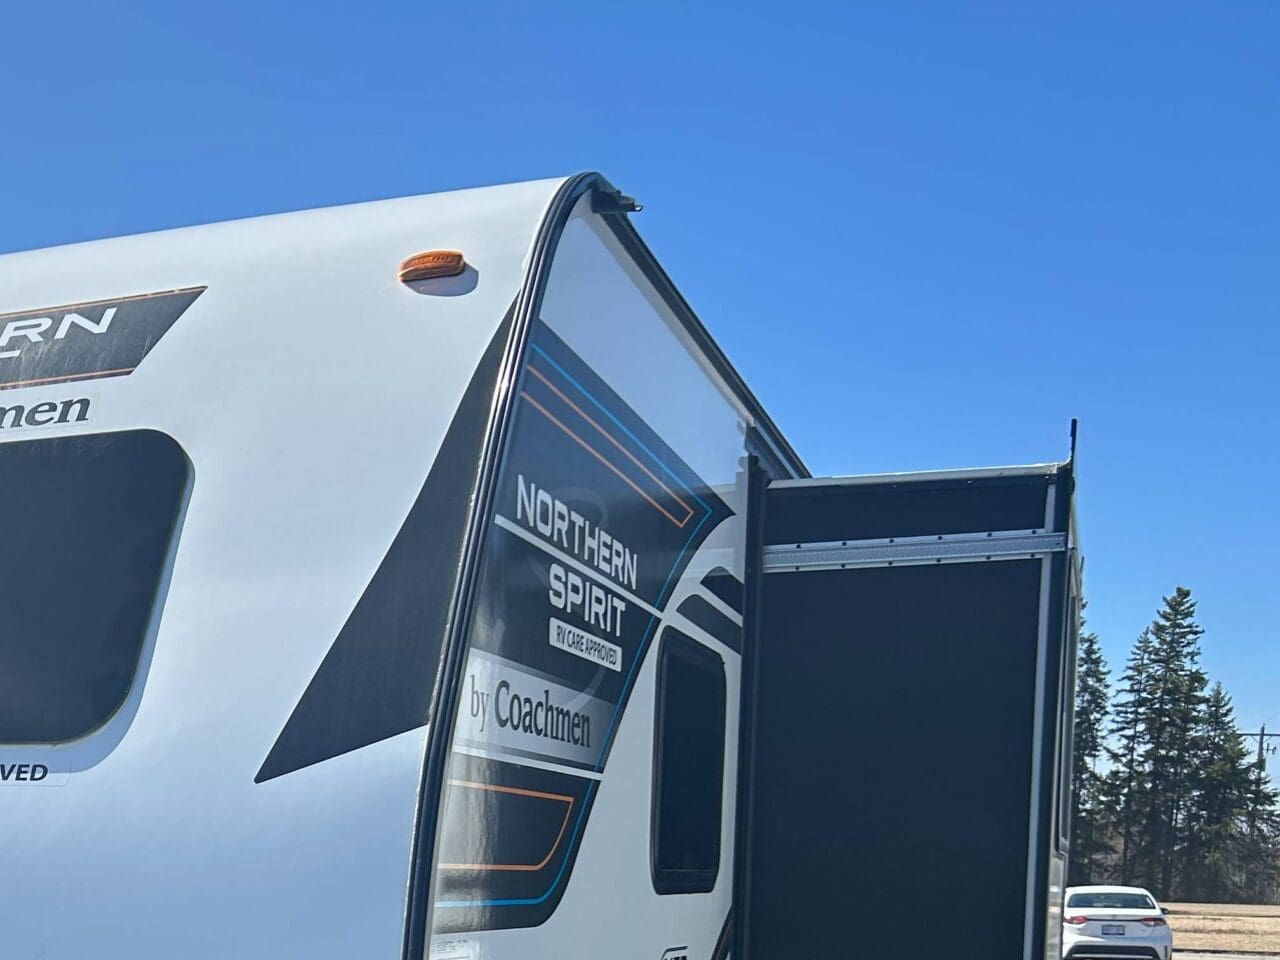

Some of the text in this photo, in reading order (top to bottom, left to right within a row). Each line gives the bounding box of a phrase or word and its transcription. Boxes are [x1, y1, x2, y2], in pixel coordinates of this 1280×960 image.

[516, 474, 638, 590] NORTHERN
[548, 563, 625, 637] SPIRIT
[556, 624, 617, 665] RV CARE APPROVED
[470, 674, 591, 748] by Coachmen
